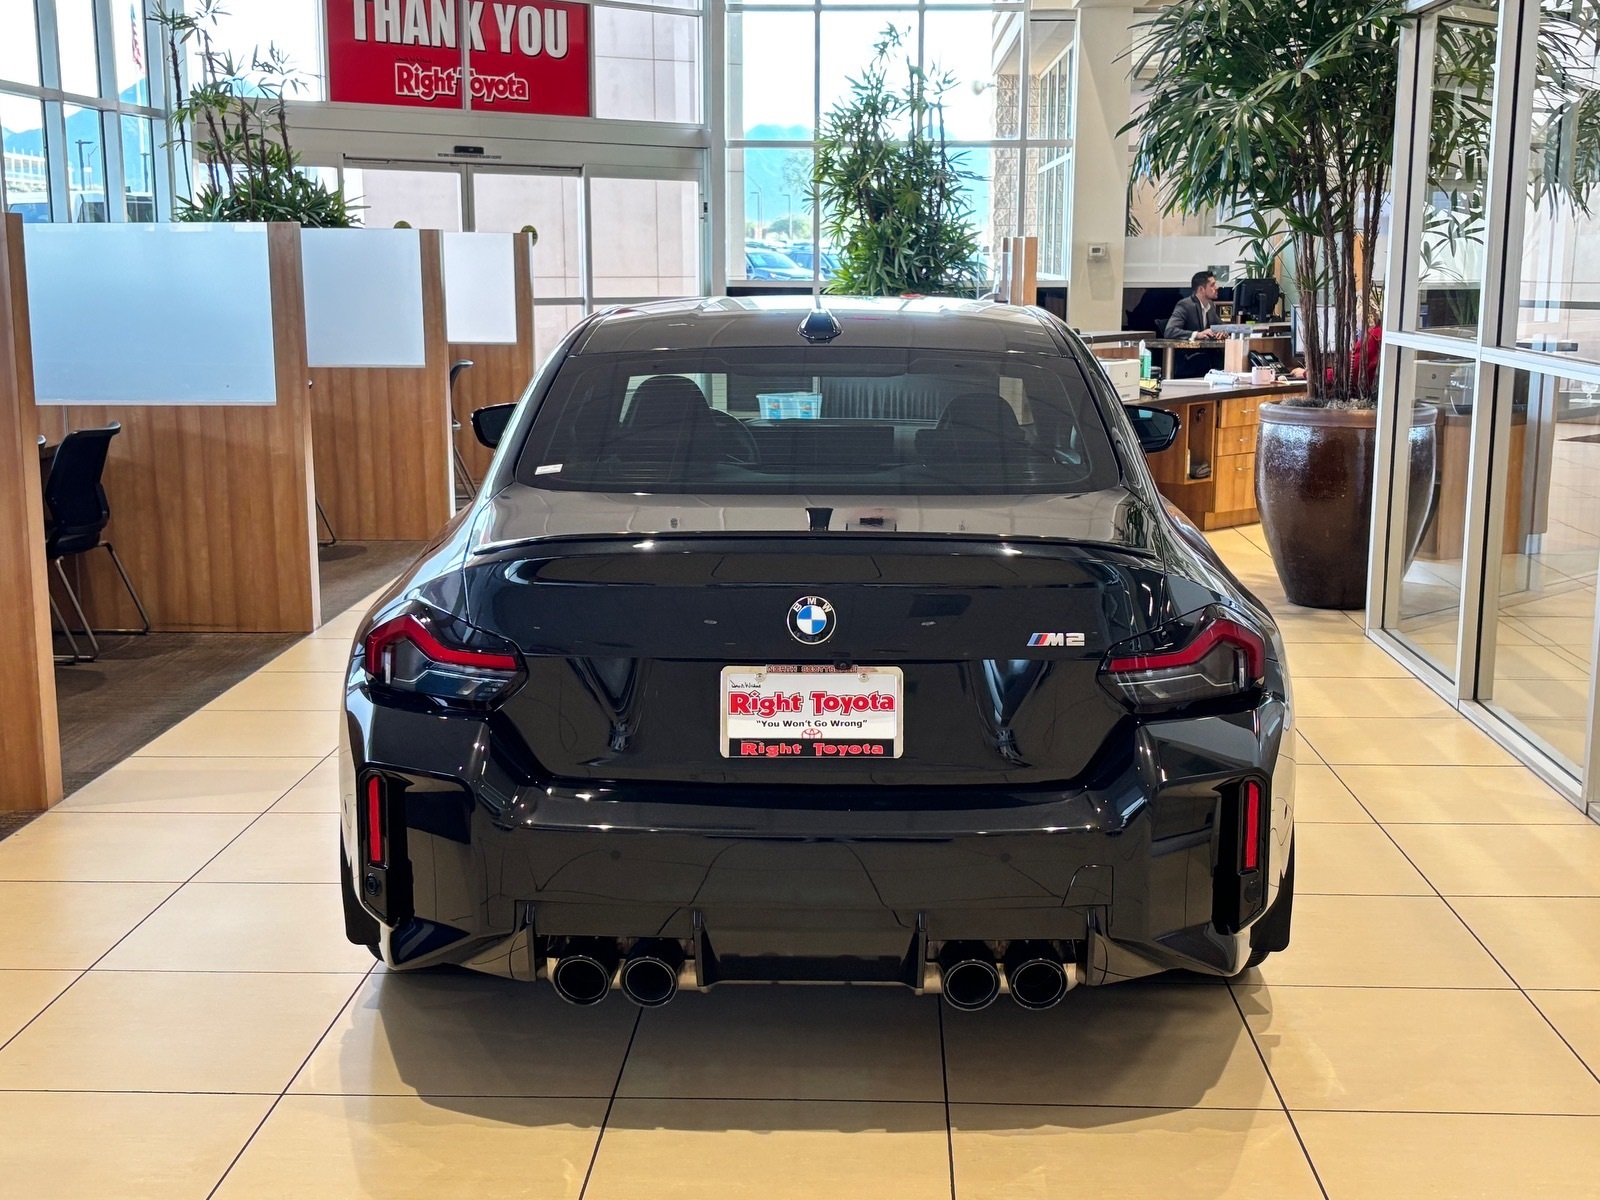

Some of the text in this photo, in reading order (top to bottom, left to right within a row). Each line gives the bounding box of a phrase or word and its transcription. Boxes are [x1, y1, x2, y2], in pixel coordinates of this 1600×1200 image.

[353, 0, 568, 58] THANK YOU
[395, 63, 457, 100] Right
[793, 597, 832, 613] BMW
[1044, 633, 1085, 646] M2
[728, 690, 896, 718] Right Toyota
[756, 720, 868, 729] "You Won't Go Wrong"
[740, 742, 884, 758] Right Toyota
